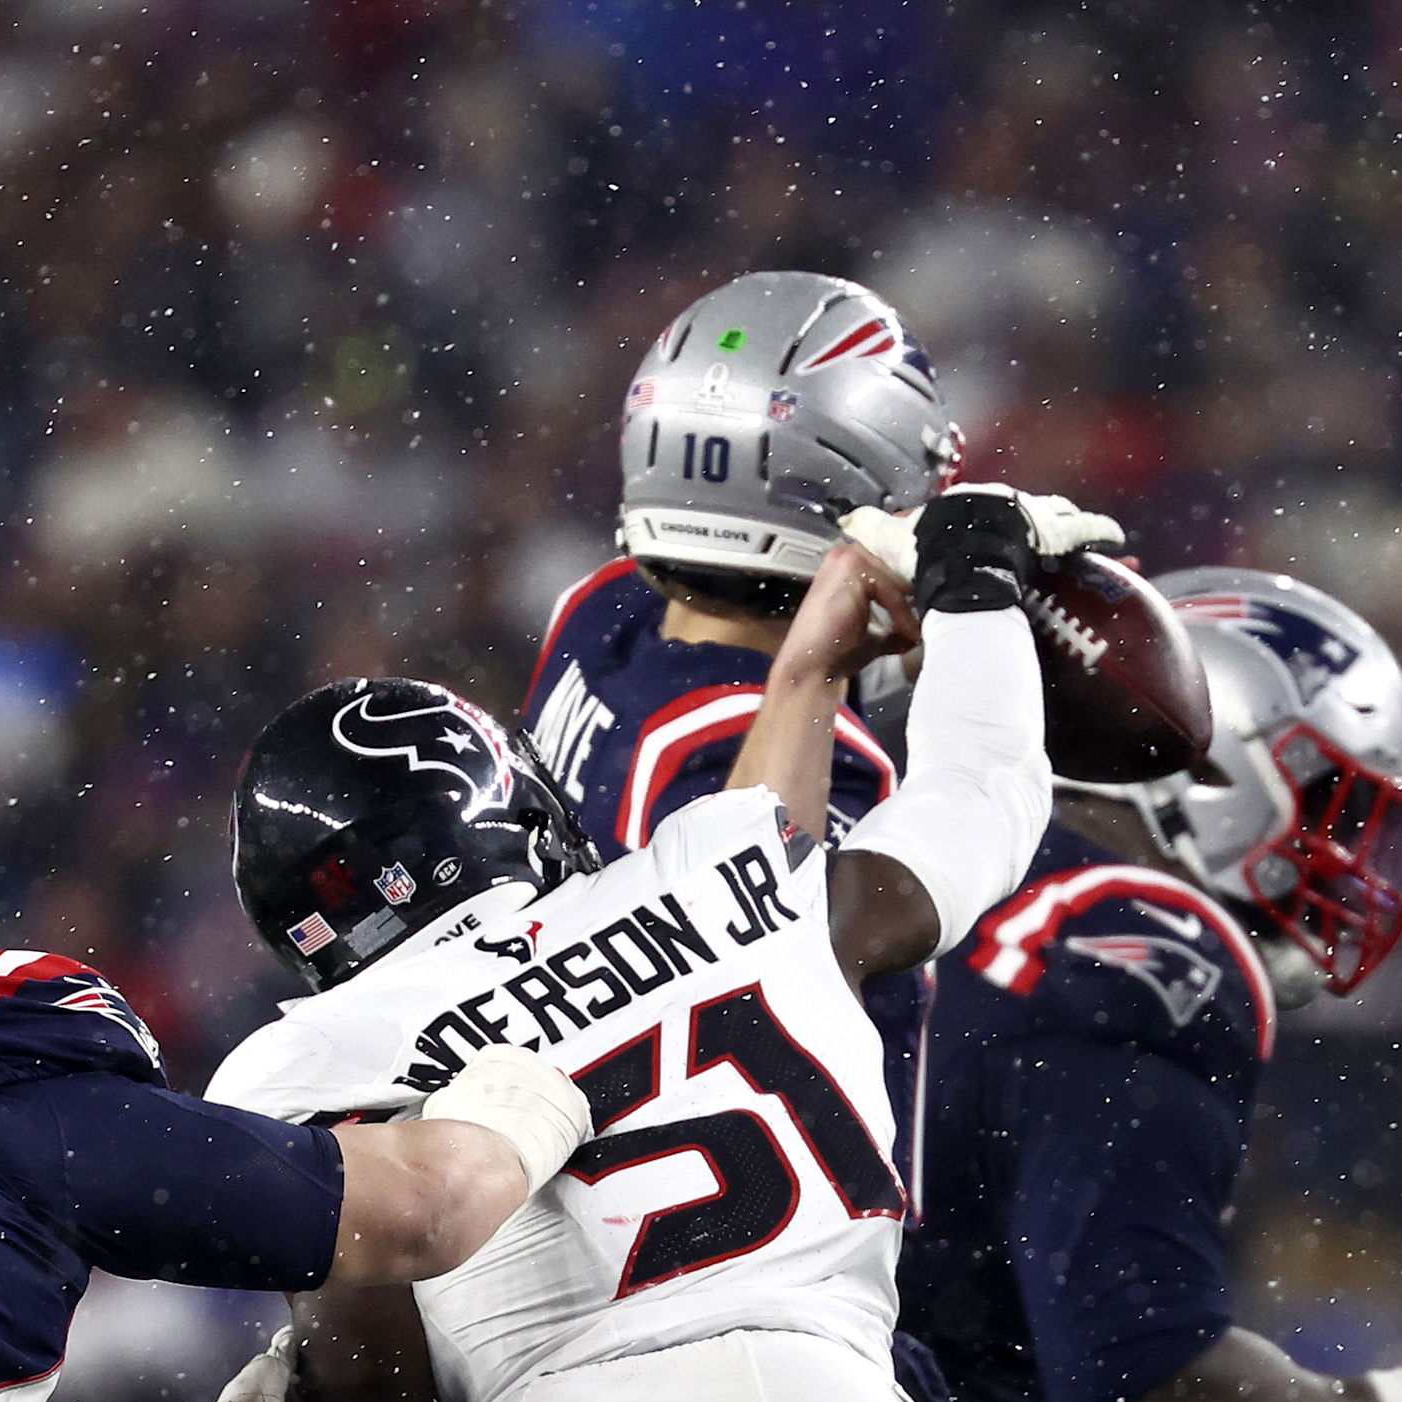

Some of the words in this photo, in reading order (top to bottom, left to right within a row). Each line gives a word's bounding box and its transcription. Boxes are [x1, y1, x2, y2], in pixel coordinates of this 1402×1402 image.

[683, 433, 730, 483] 10
[660, 521, 709, 537] CHOOSE
[714, 525, 750, 542] LOVE
[386, 877, 412, 900] NFL
[715, 844, 800, 946] JR
[558, 979, 907, 1302] 51
